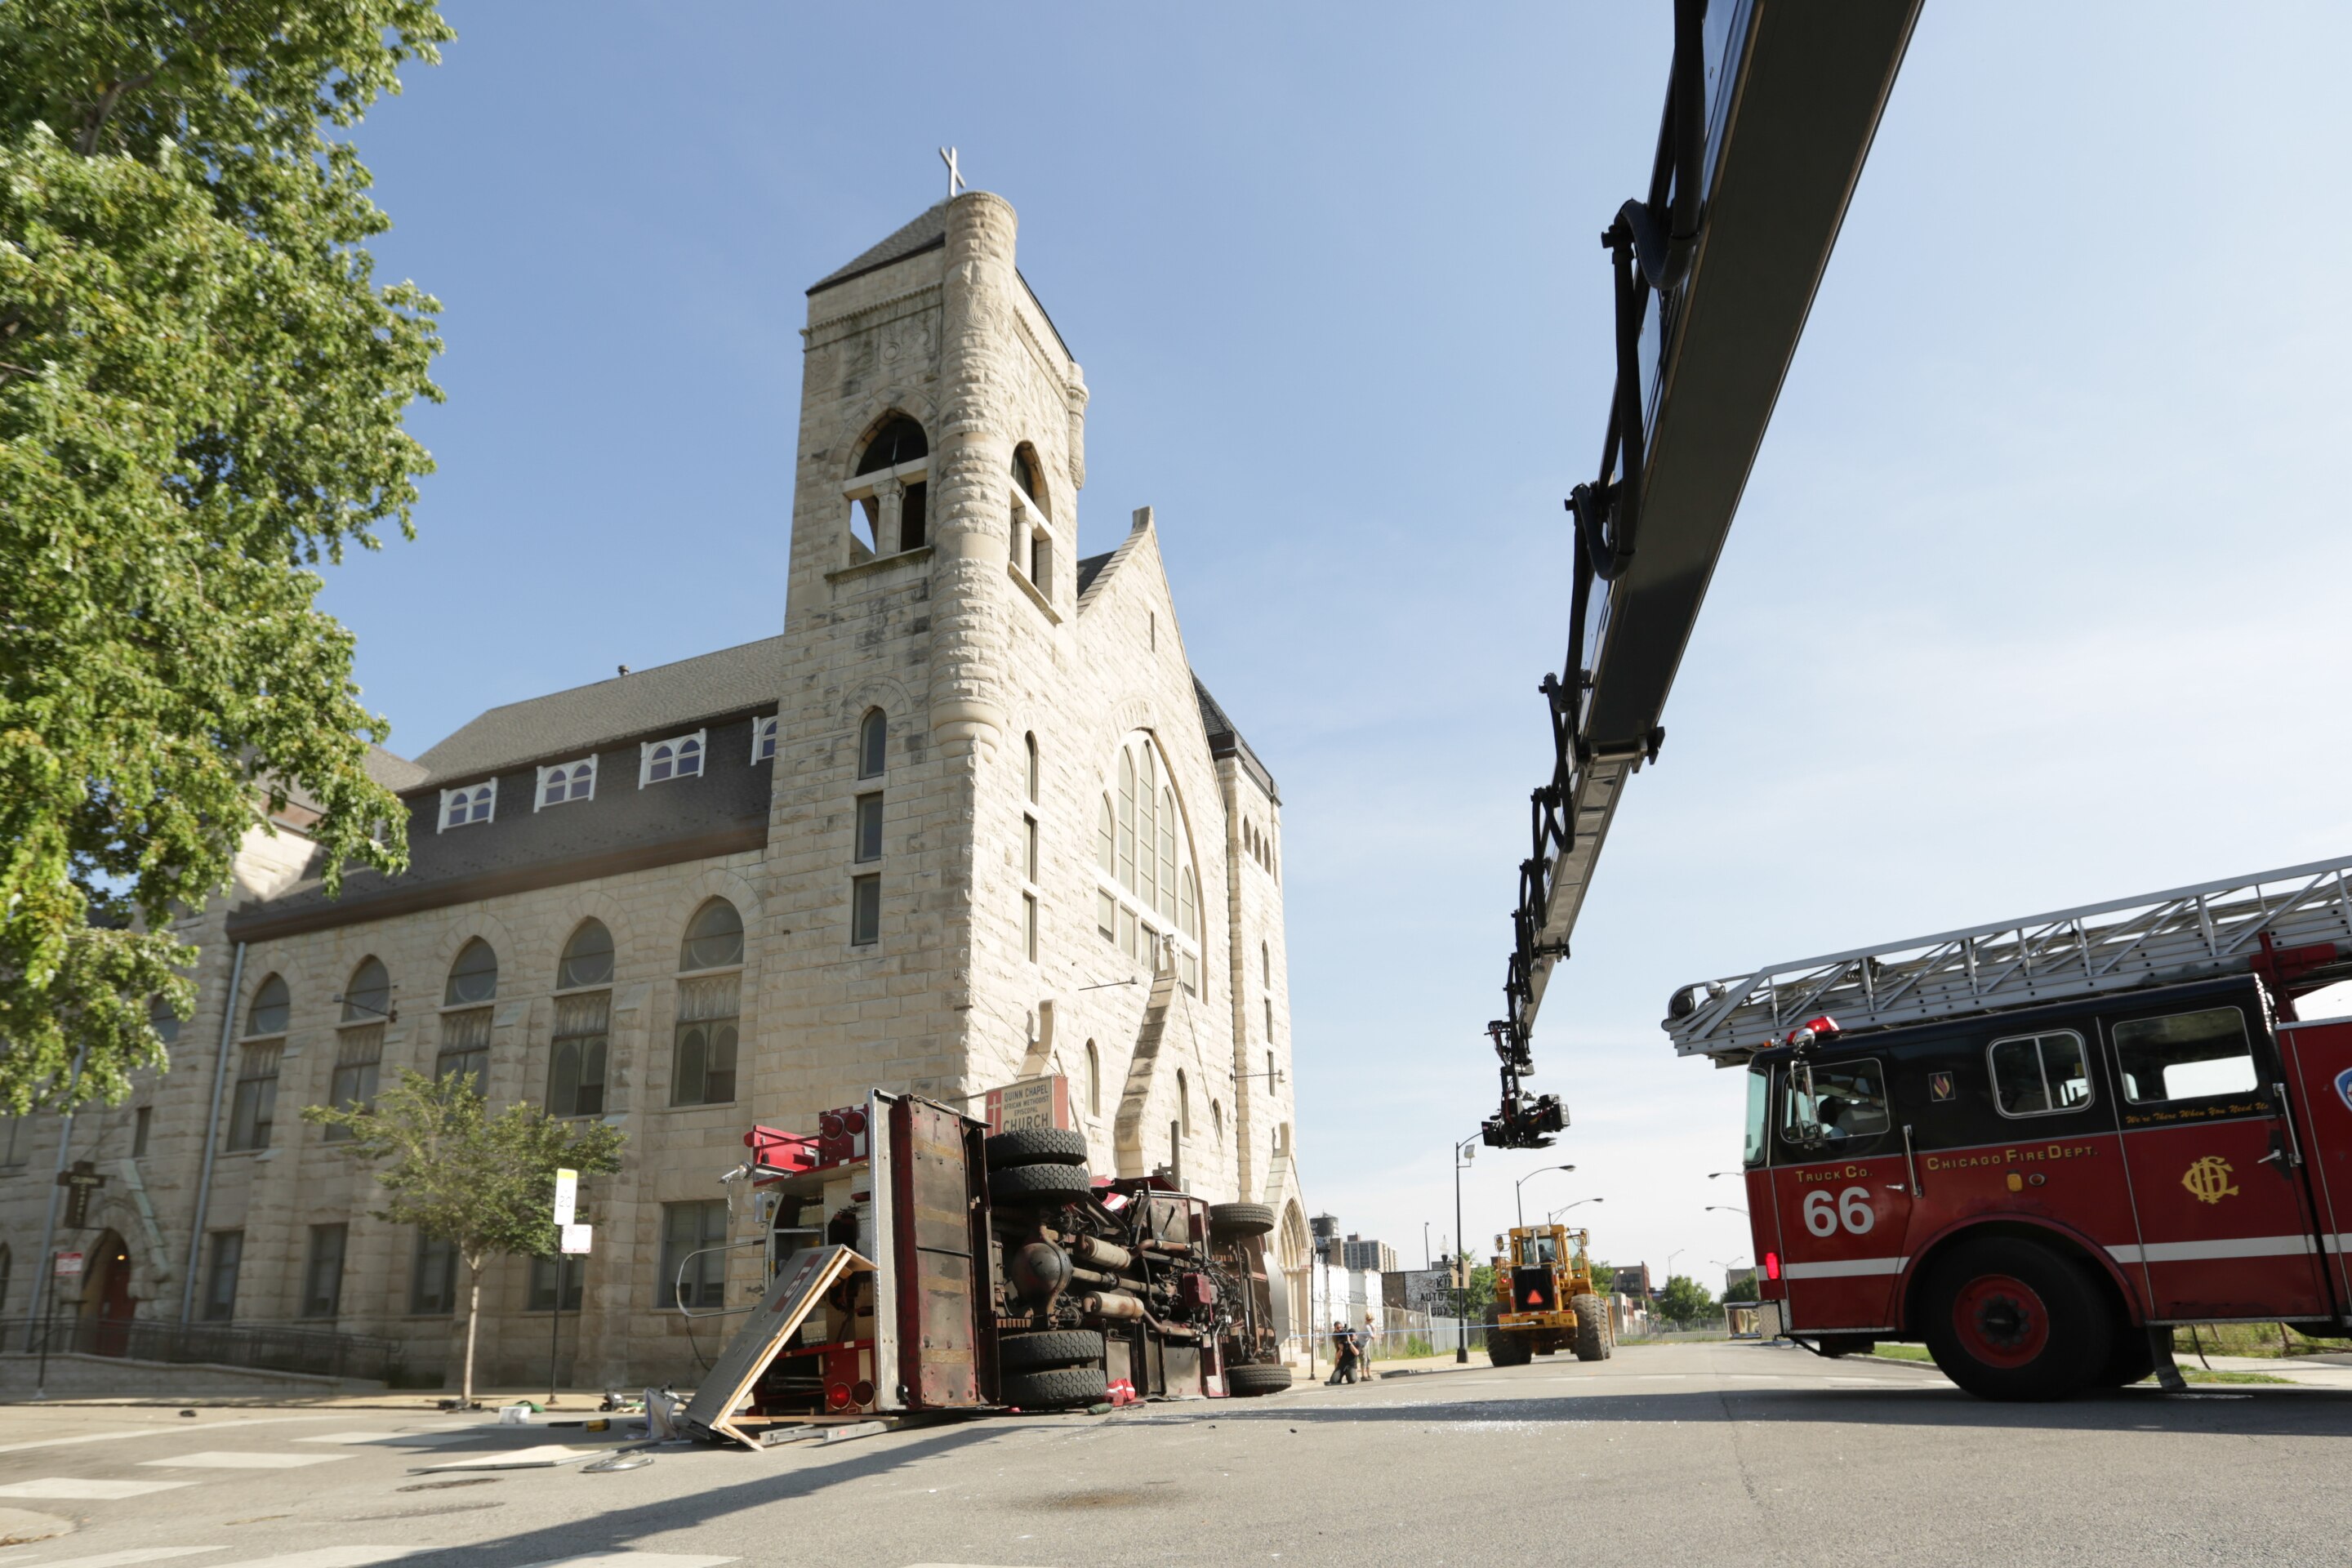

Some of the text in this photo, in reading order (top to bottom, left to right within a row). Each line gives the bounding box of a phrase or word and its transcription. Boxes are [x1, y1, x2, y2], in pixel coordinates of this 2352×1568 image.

[1004, 1085, 1048, 1102] QUINN CHAPEL
[1004, 1095, 1049, 1111] AFRICAN METHODIST
[2153, 1111, 2176, 1120] There
[2179, 1109, 2205, 1118] When
[2207, 1107, 2226, 1116] You
[2229, 1103, 2252, 1113] Need
[2255, 1102, 2269, 1111] Us
[1013, 1107, 1038, 1116] EPISCOPAL
[1003, 1112, 1049, 1133] CHURCH
[1927, 1155, 2001, 1170] CHICAGO
[2006, 1149, 2045, 1163] FIRE
[1795, 1170, 1842, 1183] TRUCK
[559, 1195, 572, 1208] 20
[1803, 1186, 1875, 1237] 66
[1419, 1292, 1444, 1302] AUTO
